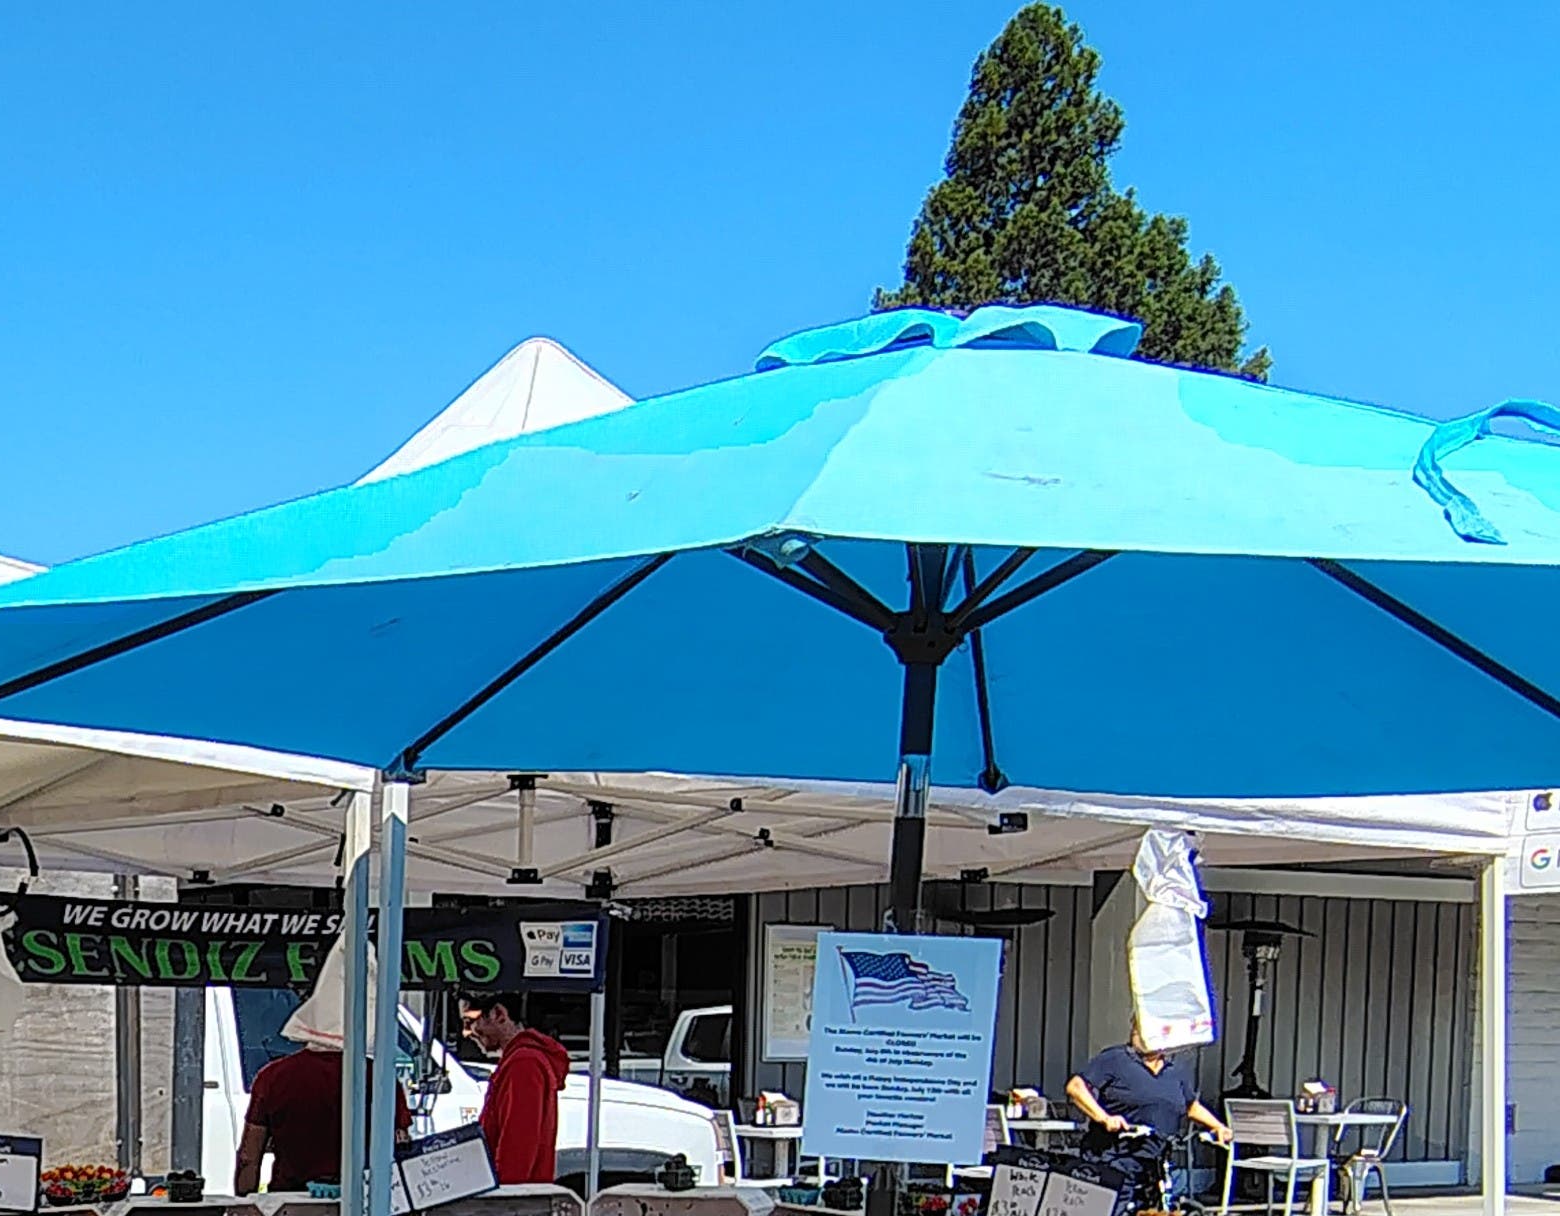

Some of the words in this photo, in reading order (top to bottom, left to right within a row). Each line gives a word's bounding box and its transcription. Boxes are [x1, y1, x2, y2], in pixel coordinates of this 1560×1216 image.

[63, 904, 108, 926] WE
[111, 907, 198, 931] GROW
[201, 912, 279, 933] WHAT
[281, 914, 322, 934] WE
[537, 929, 559, 943] Pay
[286, 940, 500, 982] FMS
[564, 955, 590, 965] VISA
